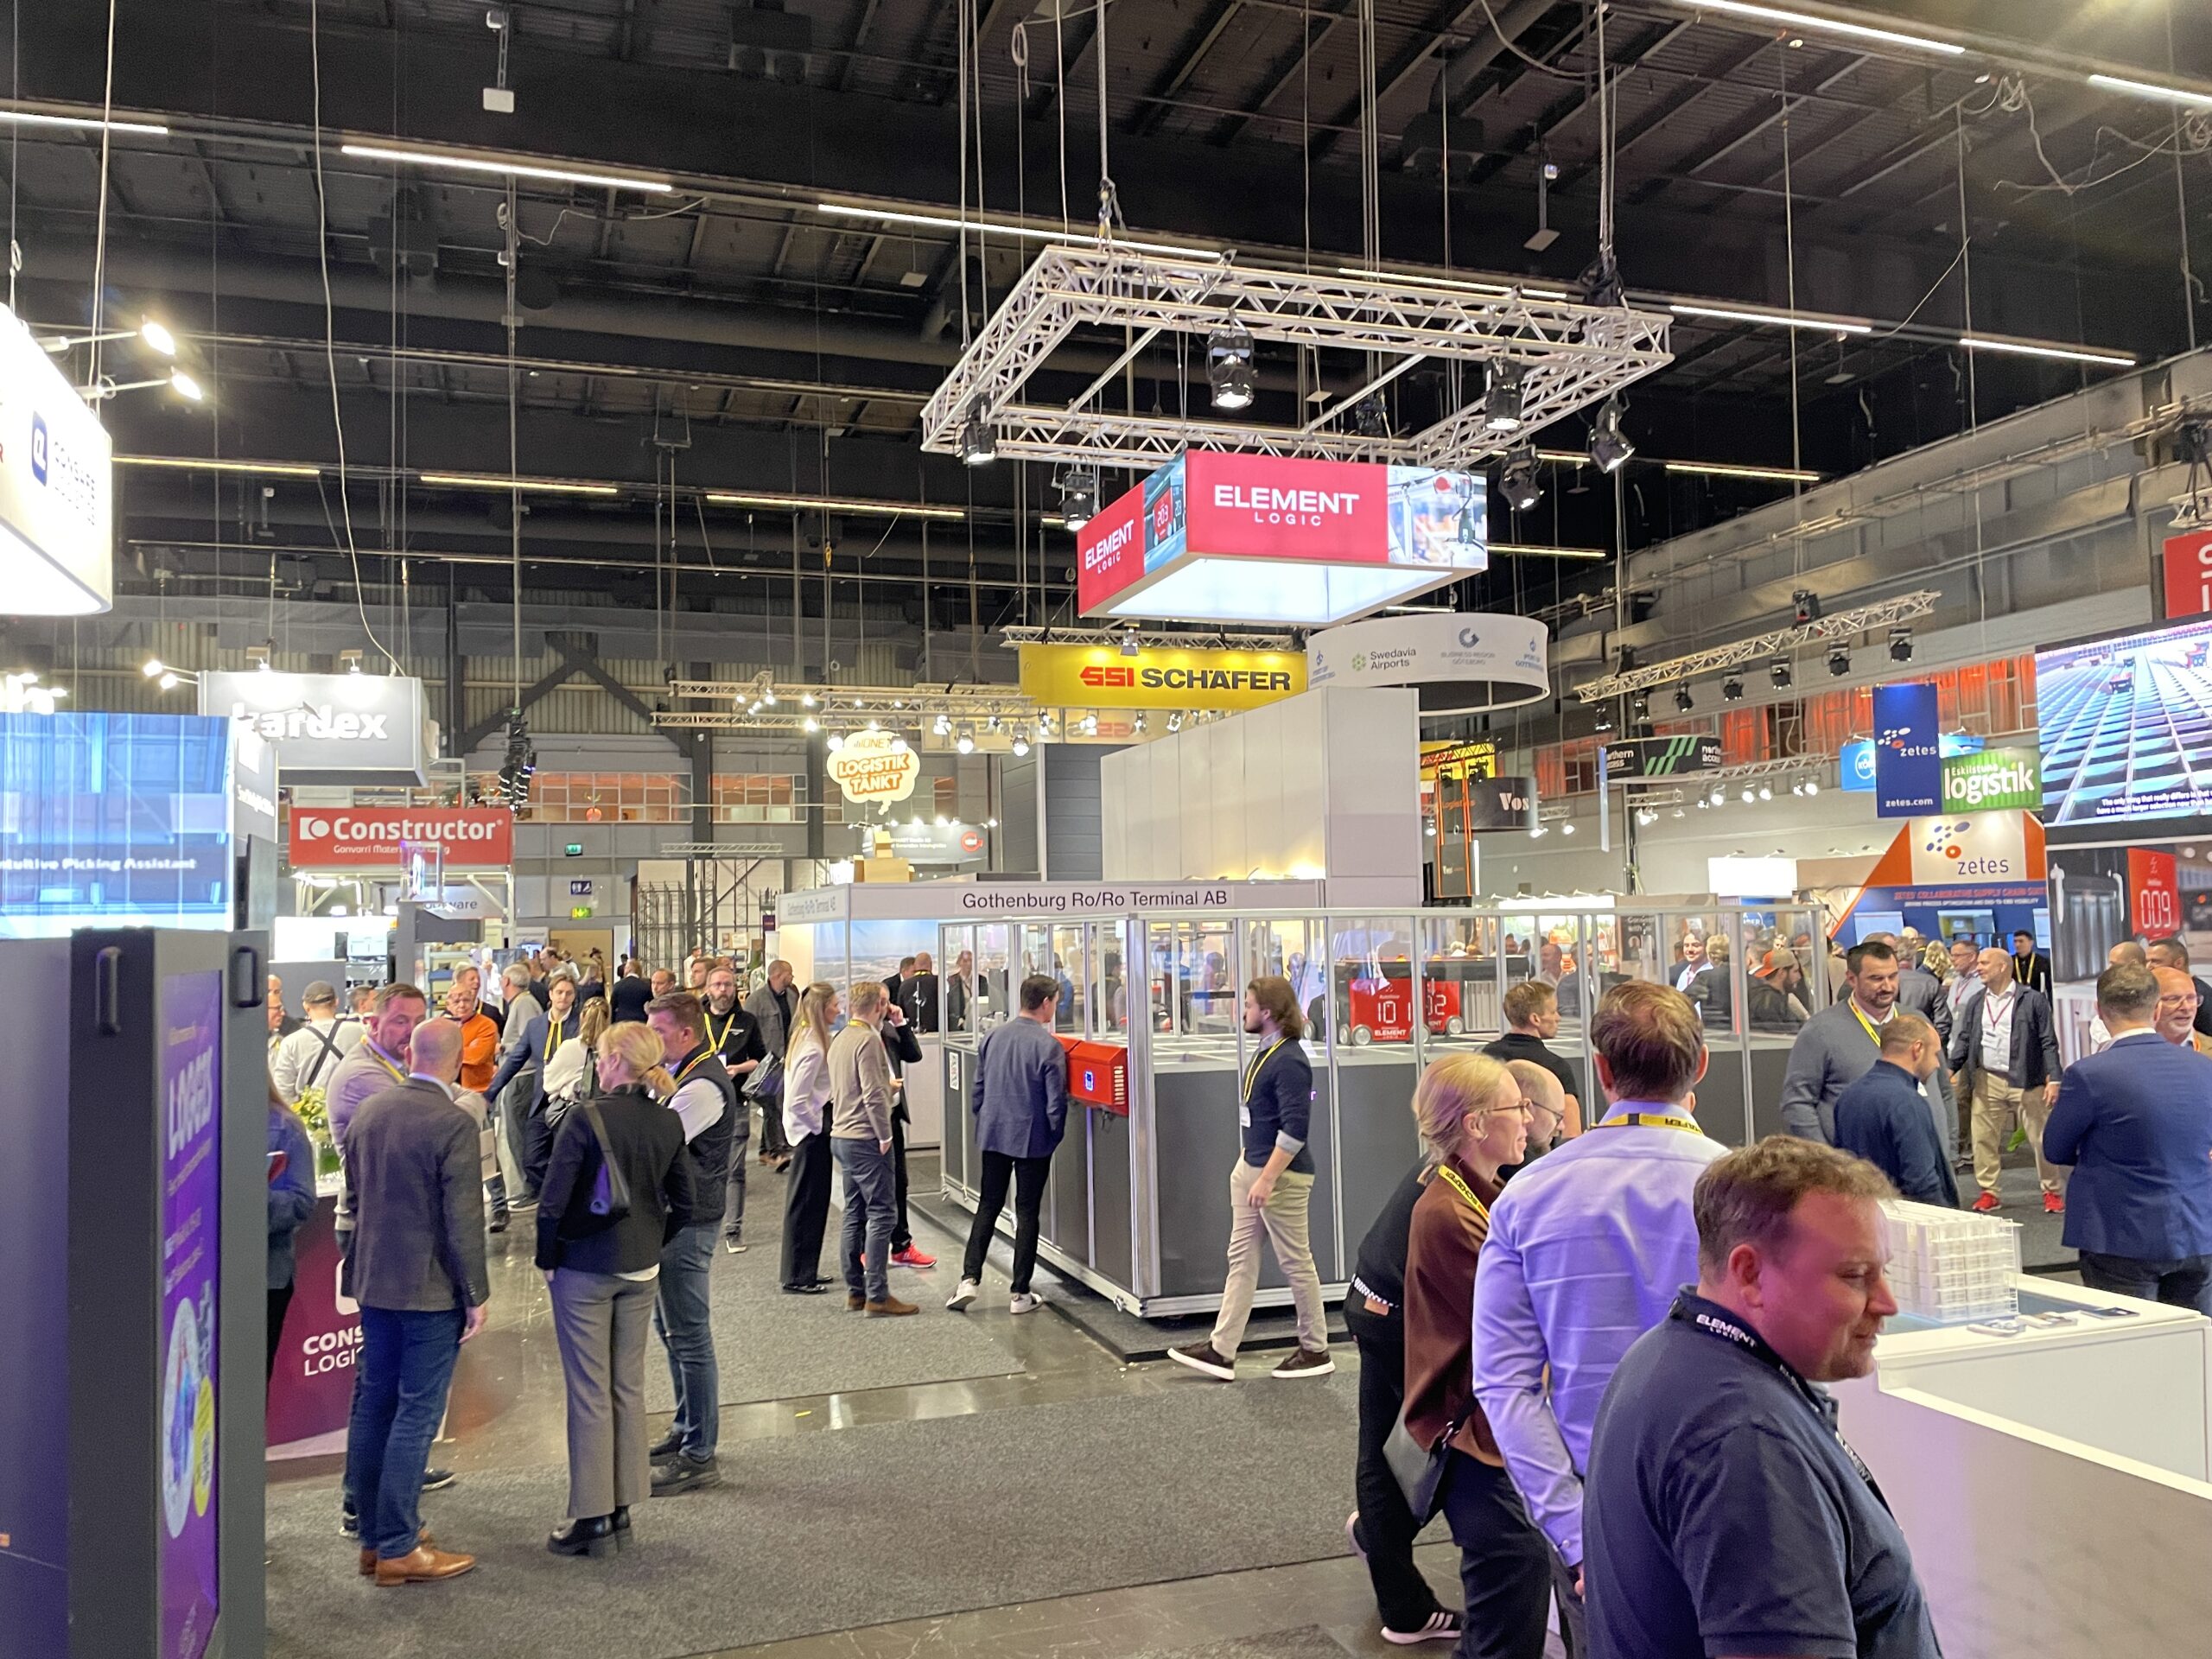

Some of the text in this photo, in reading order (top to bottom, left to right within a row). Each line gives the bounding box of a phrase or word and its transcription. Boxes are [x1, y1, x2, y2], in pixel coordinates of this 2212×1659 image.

[1214, 485, 1360, 514] ELEMENT
[1255, 512, 1321, 526] LOGIC
[1085, 519, 1135, 570] ELEMENT
[1097, 552, 1121, 574] LOGIC
[1370, 647, 1416, 659] Swedavia
[1370, 658, 1410, 671] Airports
[1079, 665, 1135, 688] SSI
[1141, 668, 1291, 690] SCHÄFER
[232, 702, 388, 741] kardex
[1900, 745, 1937, 757] zetes
[837, 753, 909, 779] LOGISTIK
[1951, 762, 1999, 777] Eskilstuna
[850, 772, 903, 796] TÄNKT
[1944, 760, 2035, 804] logistik
[1885, 798, 1933, 808] zetes.com
[334, 817, 495, 840] Constructor
[334, 845, 372, 855] Gonvarri
[62, 858, 122, 871] Picking
[124, 858, 197, 869] Assistant
[1957, 857, 2009, 875] zetes
[963, 891, 1227, 910] Gothenburg Ro/Ro Terminal AB
[2140, 889, 2171, 929] 009
[302, 1324, 365, 1356] CONS
[1696, 1313, 1758, 1348] ELEMENT
[304, 1345, 364, 1376] LOGI
